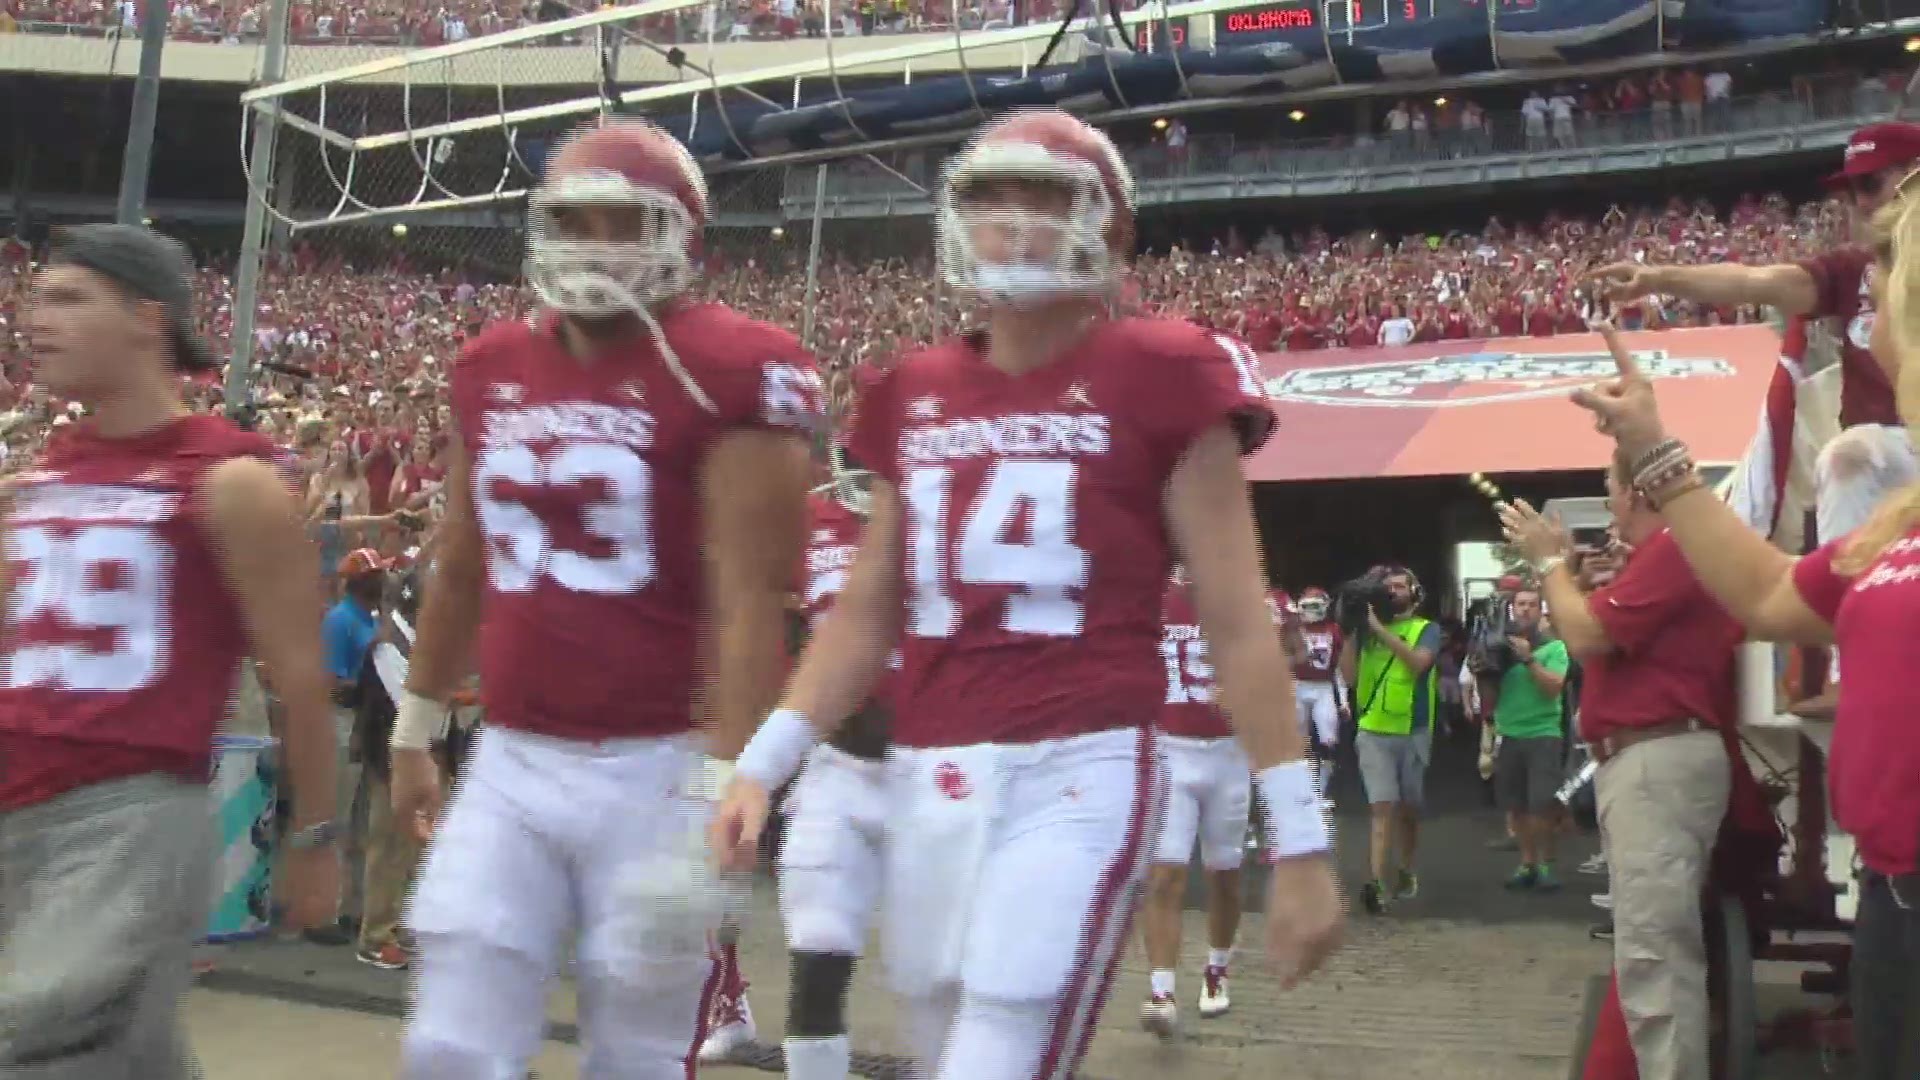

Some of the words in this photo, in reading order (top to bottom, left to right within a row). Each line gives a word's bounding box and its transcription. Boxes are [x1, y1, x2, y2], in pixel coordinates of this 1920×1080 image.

[1228, 9, 1312, 31] OKLAHOMA
[899, 414, 1110, 461] SOONERS
[473, 442, 657, 593] 63
[902, 459, 1092, 637] 14
